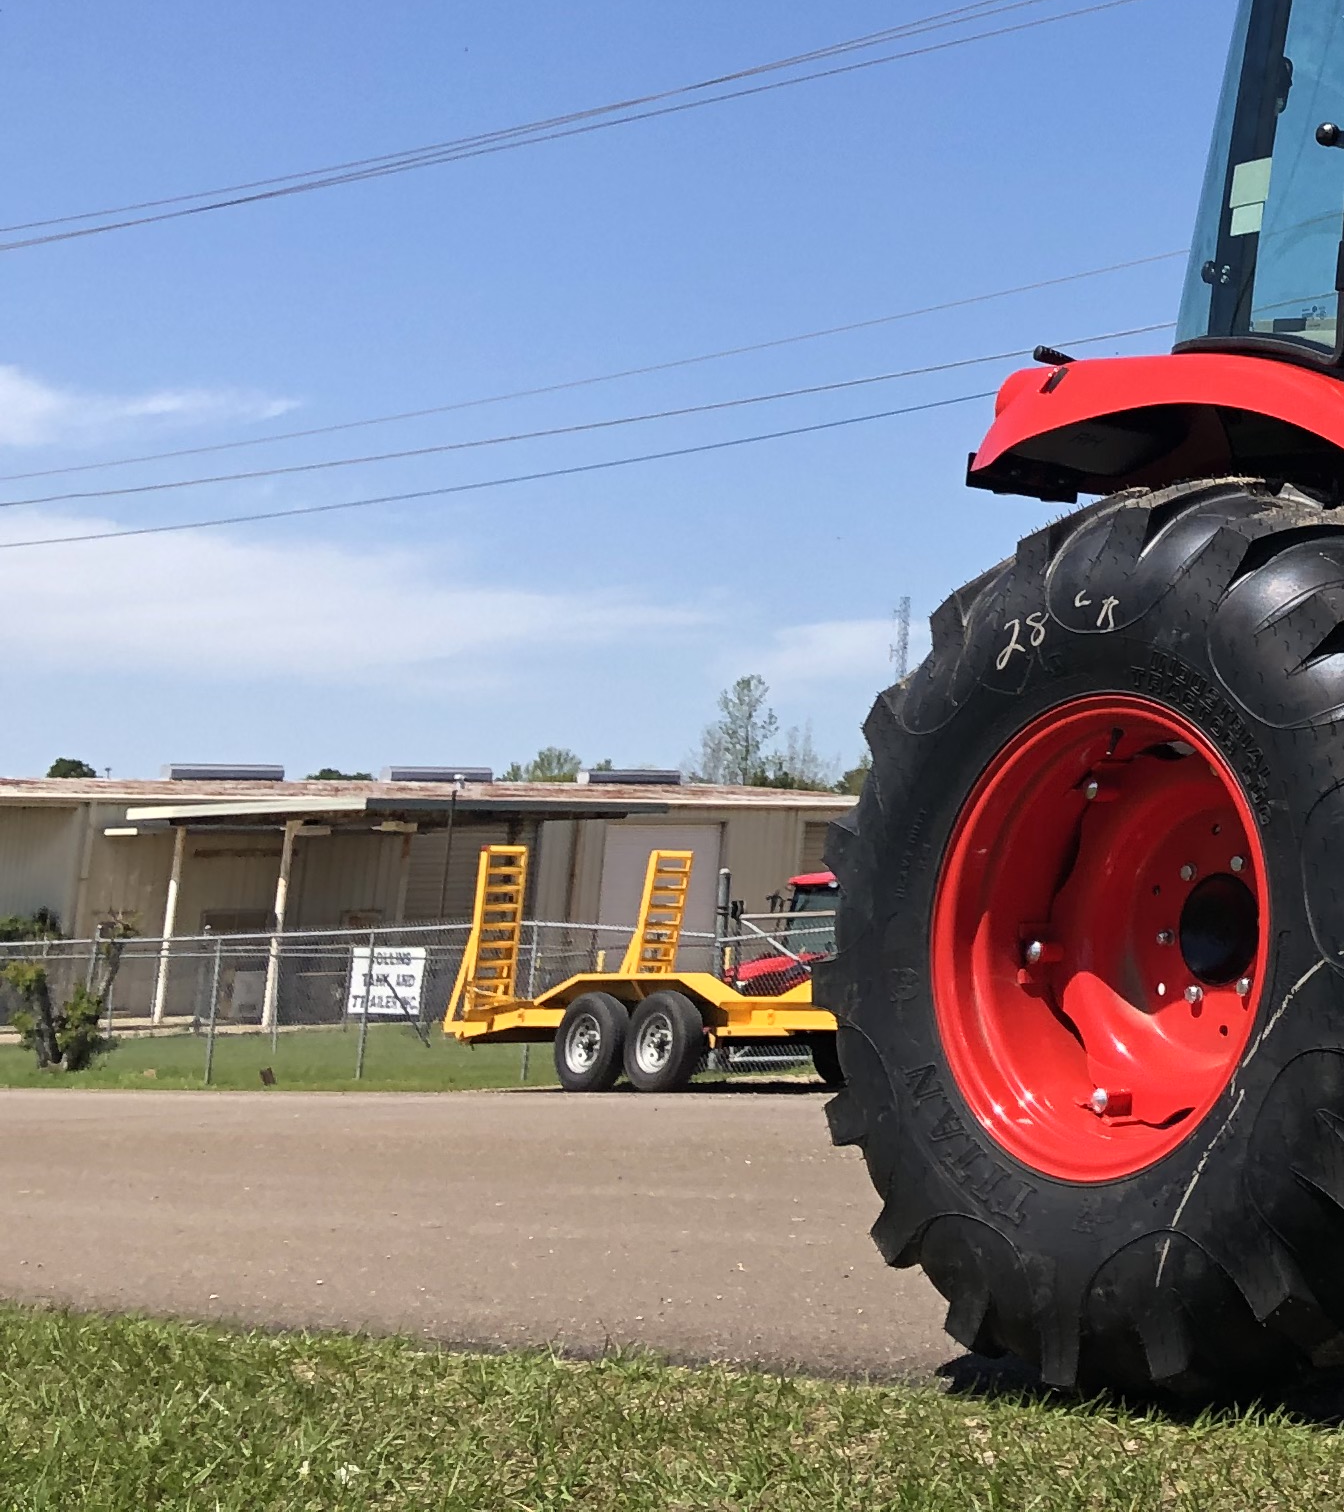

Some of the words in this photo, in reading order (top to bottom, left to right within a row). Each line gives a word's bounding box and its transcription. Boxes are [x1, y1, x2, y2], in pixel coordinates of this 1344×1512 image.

[995, 611, 1050, 671] 28
[372, 951, 412, 966] OLLINS
[902, 1062, 1039, 1226] TITAN
